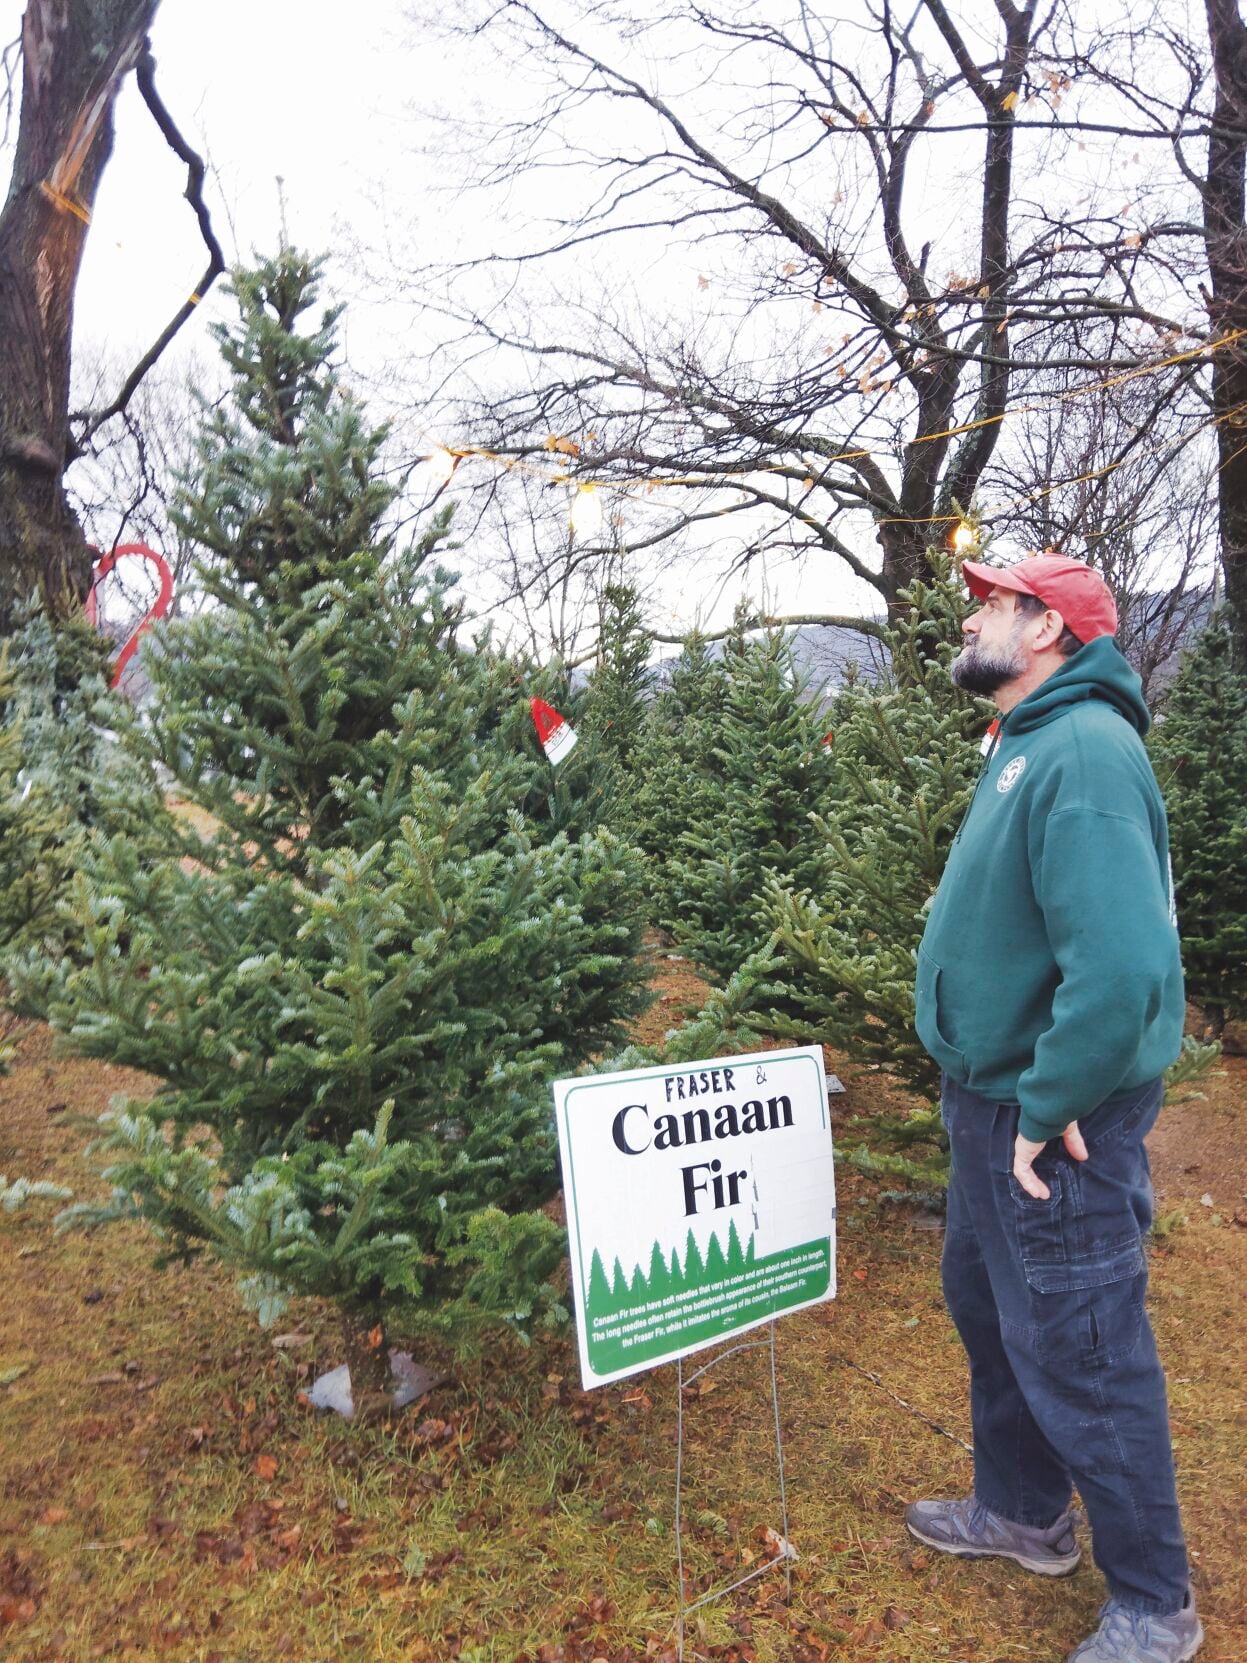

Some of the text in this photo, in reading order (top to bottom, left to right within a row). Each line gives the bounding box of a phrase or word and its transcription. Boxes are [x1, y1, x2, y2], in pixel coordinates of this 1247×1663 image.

[665, 1065, 767, 1102] FRASER &
[611, 1094, 796, 1156] Canaan
[679, 1158, 748, 1217] Fir
[592, 1332, 605, 1343] The
[606, 1327, 621, 1339] long
[622, 1319, 647, 1333] needles
[647, 1314, 664, 1325] often
[664, 1308, 682, 1319] retain
[683, 1304, 693, 1313] the
[693, 1293, 725, 1310] bottlebrush
[725, 1284, 756, 1300] appearance
[593, 1313, 619, 1327] Canaan
[619, 1309, 629, 1320] Fir
[629, 1305, 646, 1316] trees
[646, 1300, 662, 1311] have
[662, 1295, 675, 1306] soft
[675, 1289, 699, 1301] needles
[699, 1284, 711, 1294] that
[724, 1278, 730, 1287] in
[730, 1274, 744, 1285] color
[745, 1270, 756, 1280] and
[622, 1338, 633, 1348] the
[633, 1330, 654, 1344] Fraser
[666, 1321, 682, 1333] while
[711, 1309, 720, 1318] the
